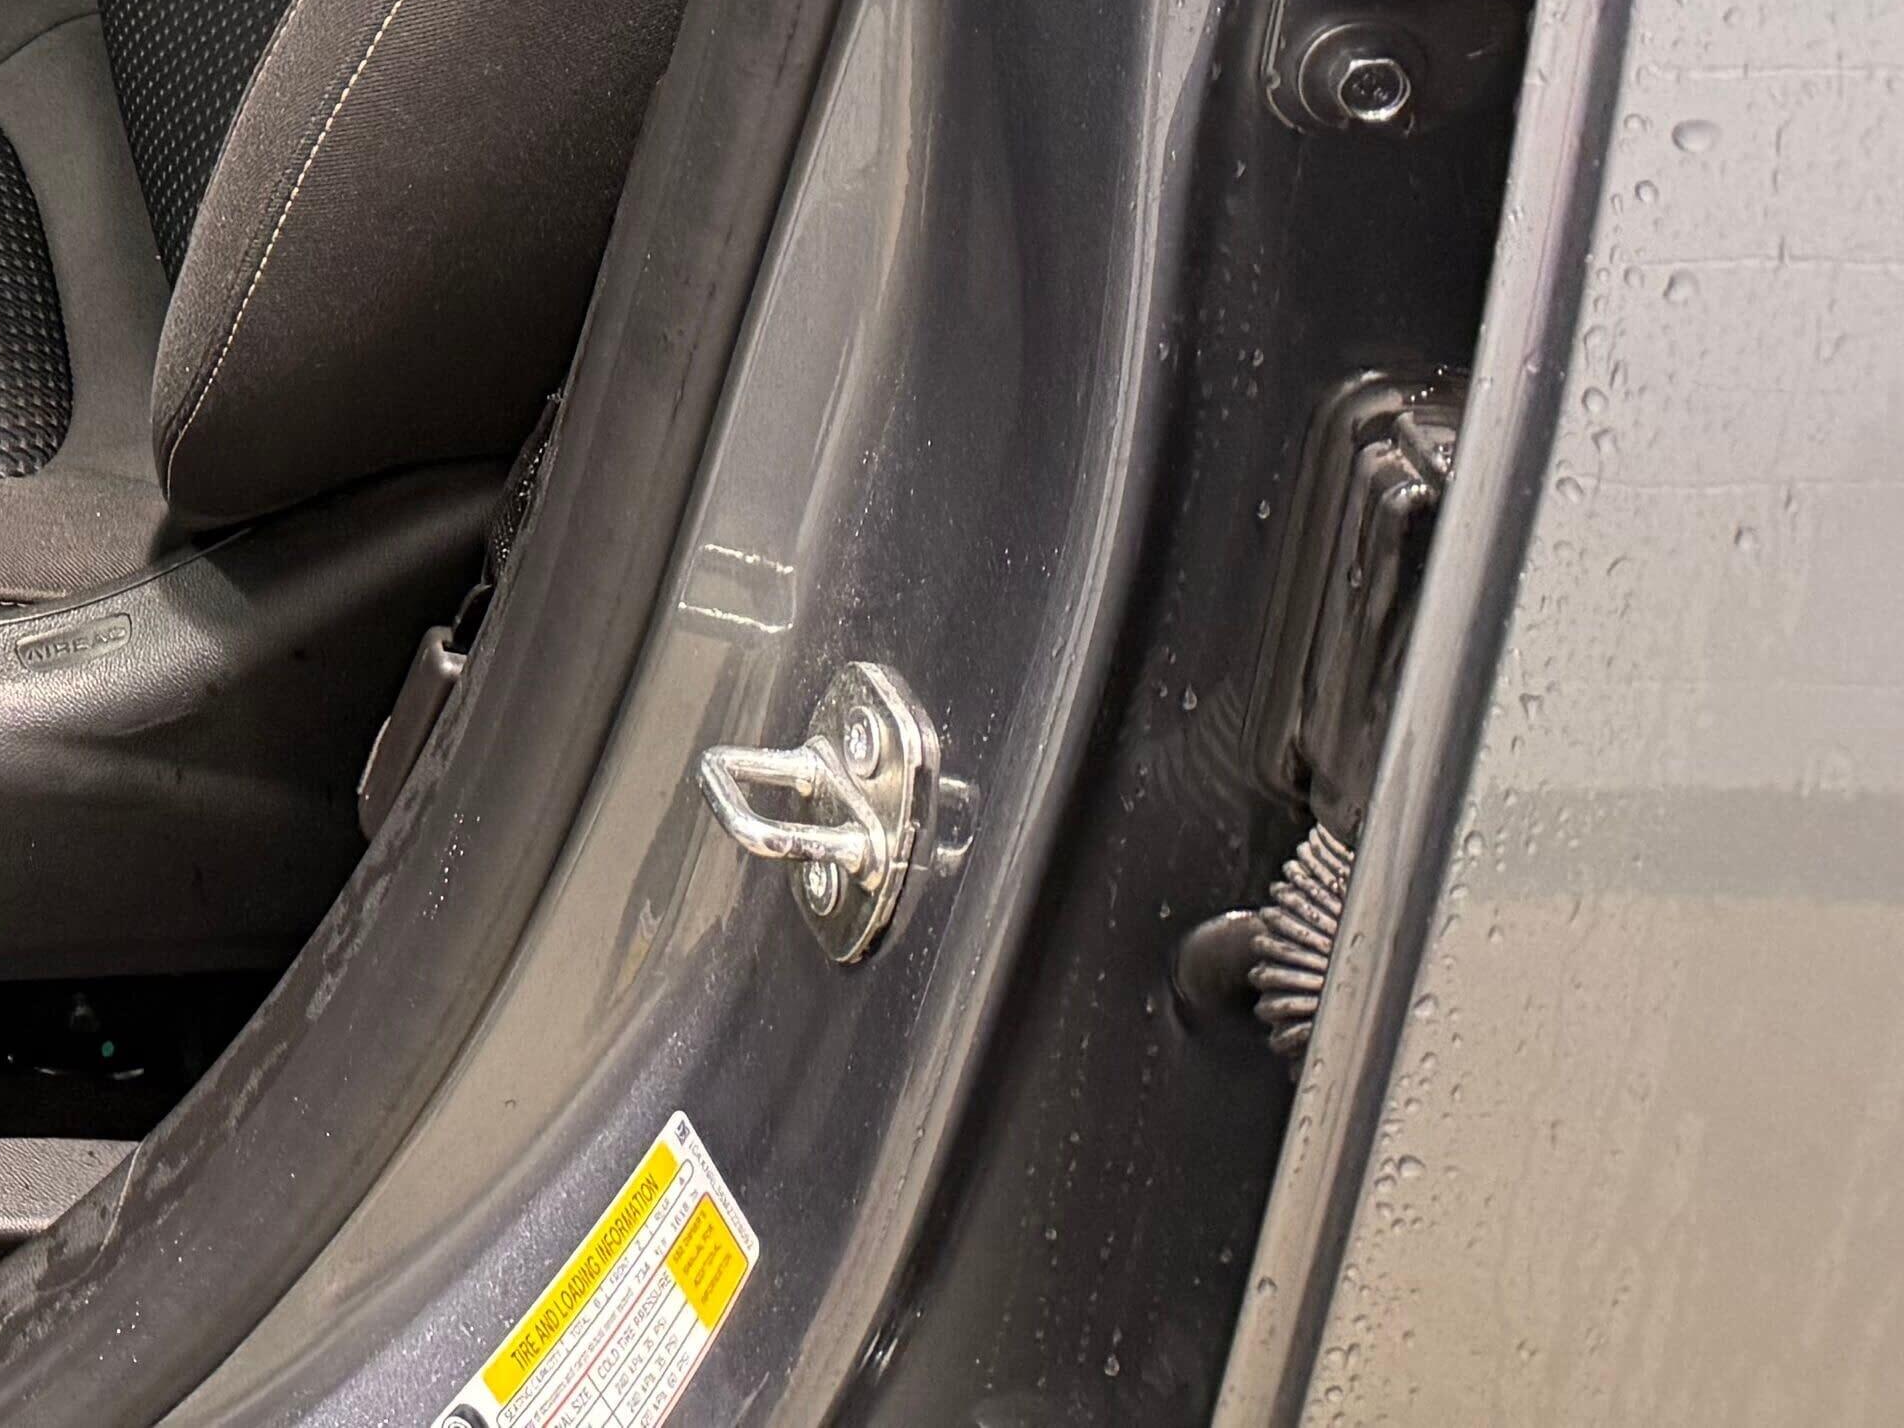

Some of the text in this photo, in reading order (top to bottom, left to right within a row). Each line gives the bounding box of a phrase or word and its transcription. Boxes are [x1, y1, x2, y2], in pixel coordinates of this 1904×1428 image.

[25, 626, 127, 662] AIRBAG
[511, 1173, 660, 1372] TIRE AND LOADING INFORMATION
[597, 1350, 619, 1379] COLD
